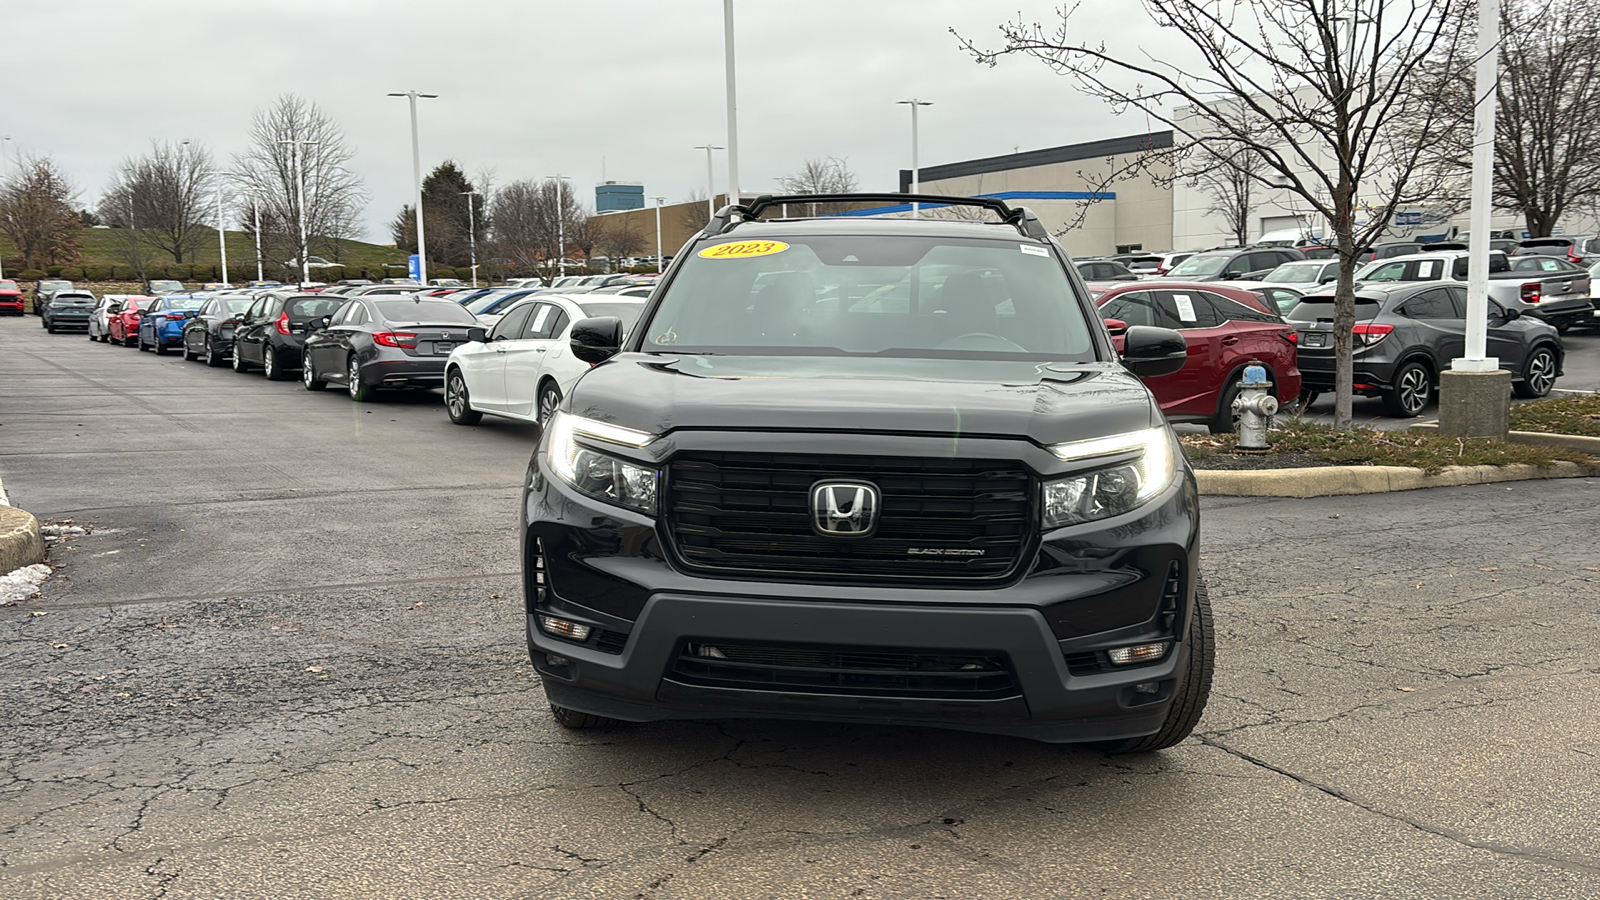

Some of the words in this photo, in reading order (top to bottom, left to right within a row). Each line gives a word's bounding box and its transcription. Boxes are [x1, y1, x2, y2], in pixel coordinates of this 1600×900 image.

[712, 242, 776, 257] 2023
[907, 547, 943, 555] BLACK
[944, 548, 986, 556] EDITION
